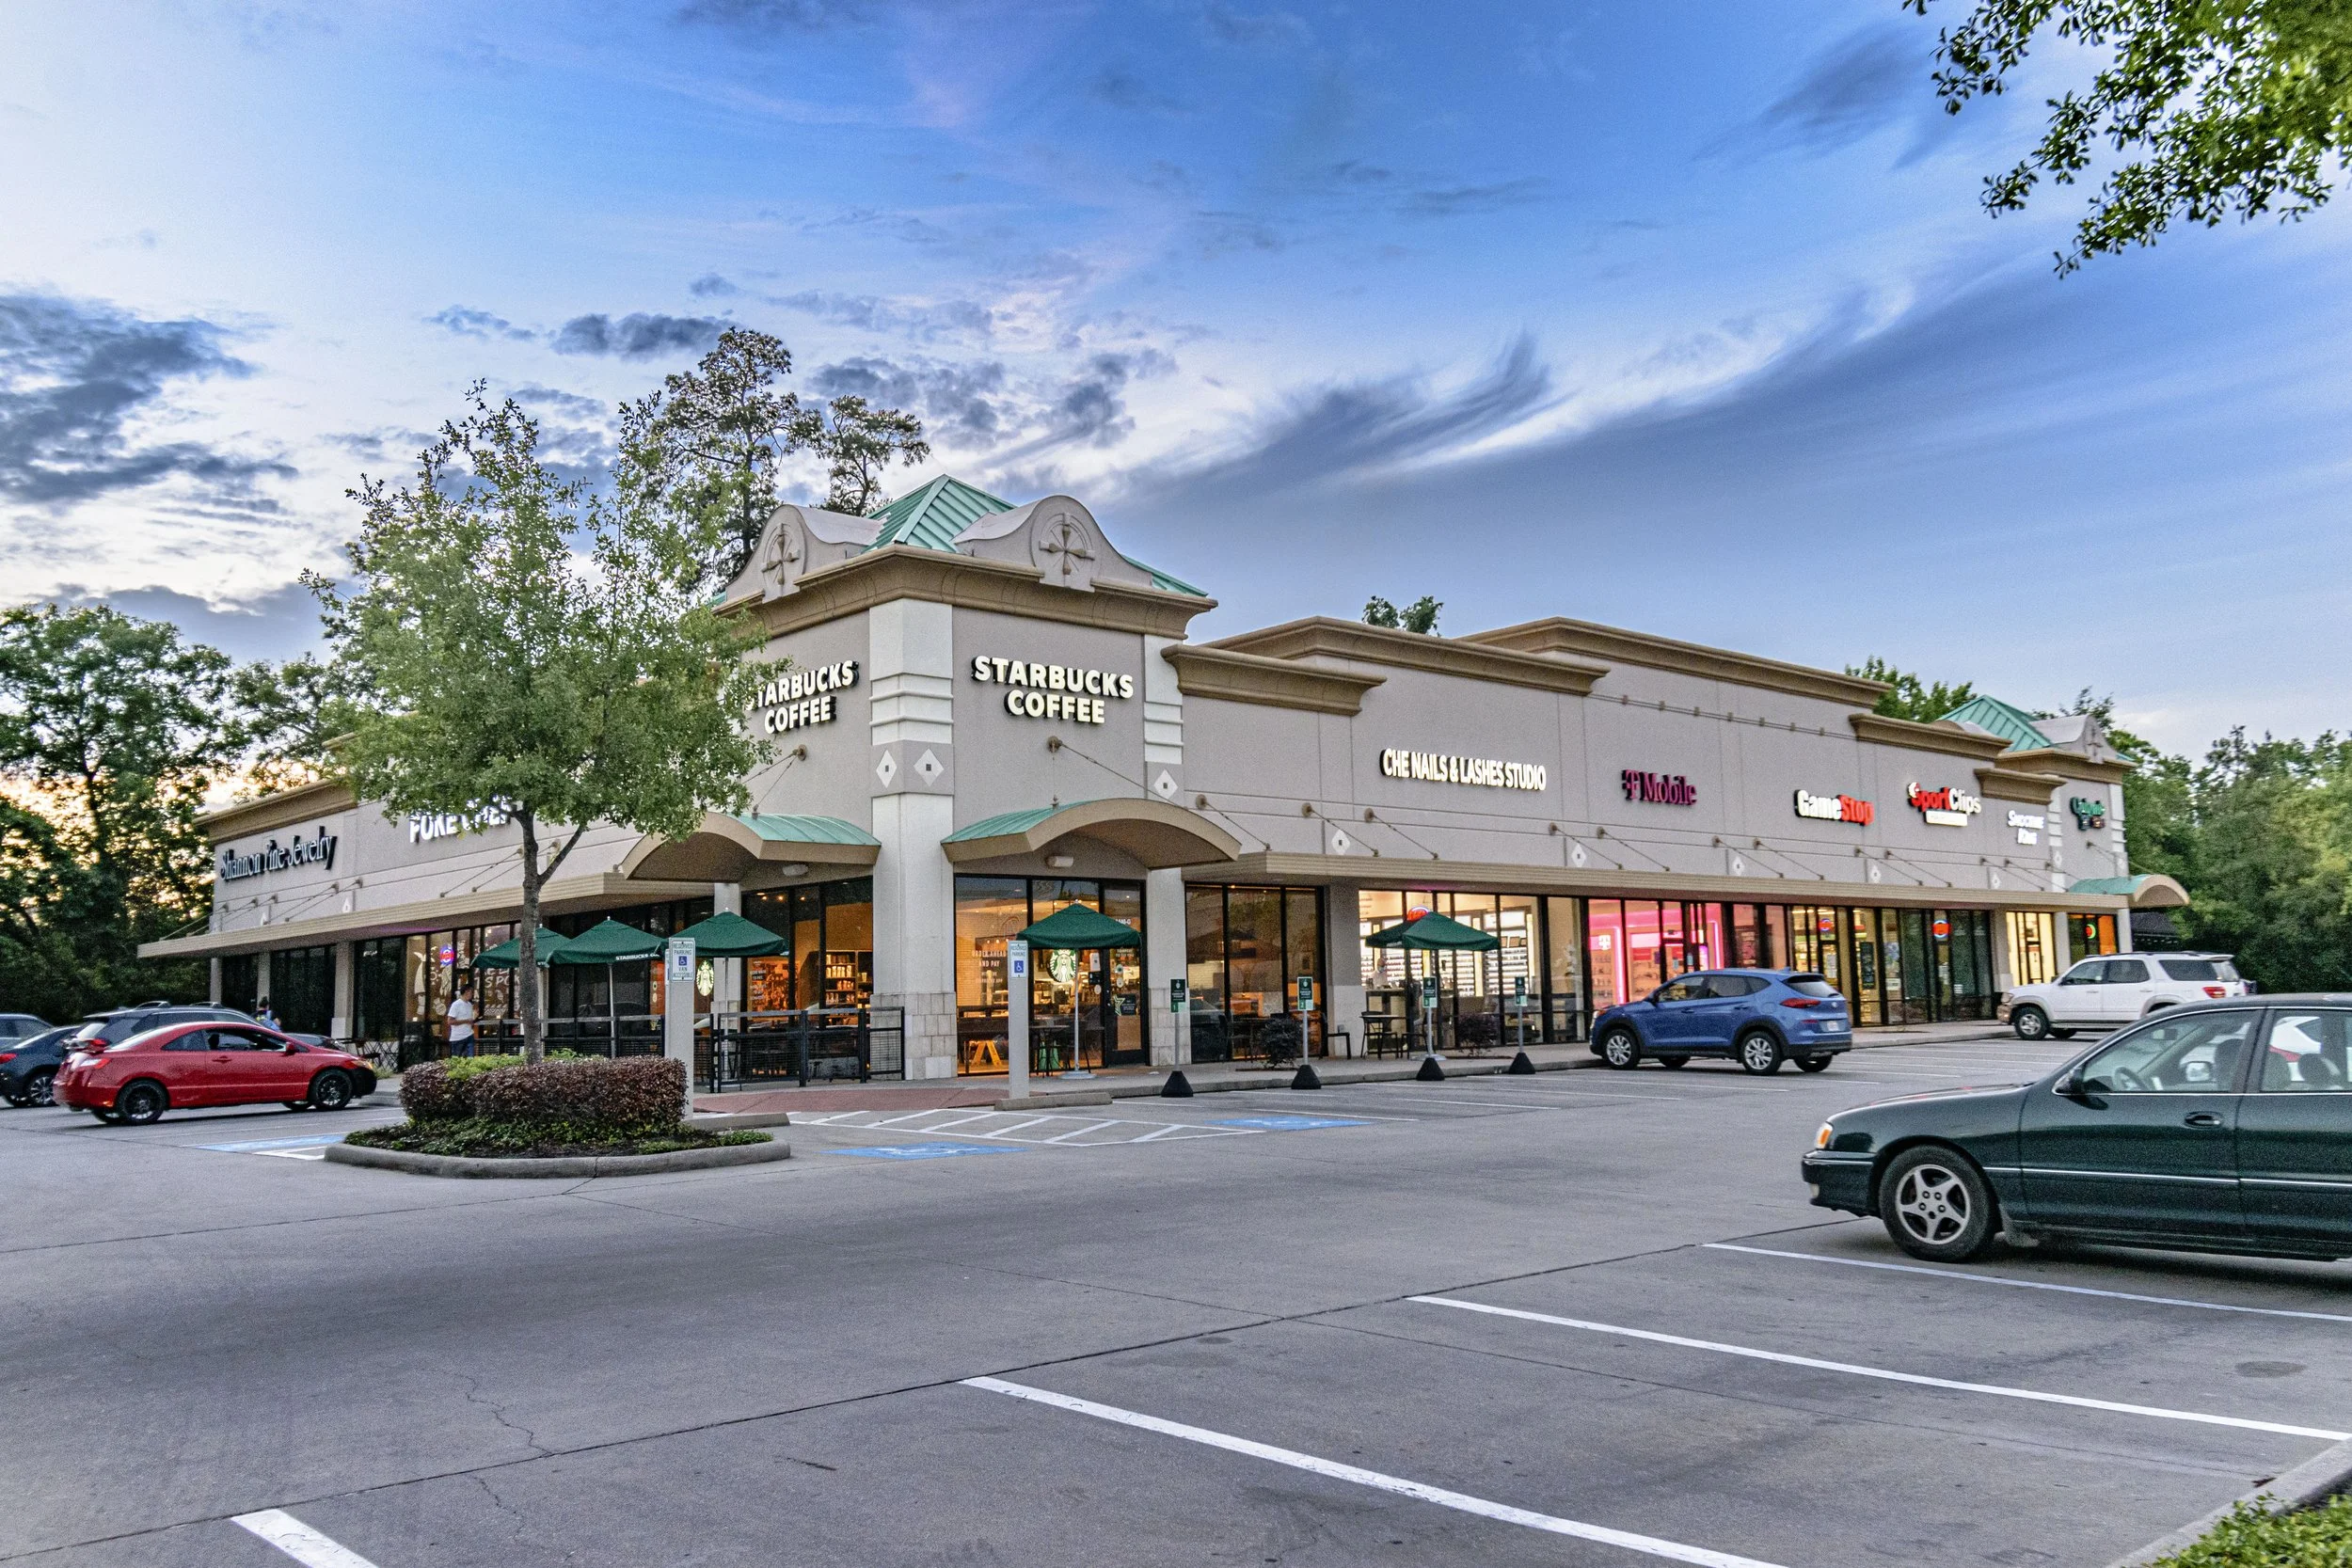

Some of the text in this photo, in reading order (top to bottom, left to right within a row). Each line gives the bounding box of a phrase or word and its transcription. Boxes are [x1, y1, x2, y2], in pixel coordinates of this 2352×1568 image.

[973, 656, 1134, 699] STARBUCKS
[764, 695, 834, 735] COFFEE
[1006, 689, 1105, 724] COFFEE
[1380, 748, 1548, 791] CHE NAILS & LASHES STUDIO
[1641, 771, 1697, 805] Mobile
[1795, 789, 1875, 826] GameStop
[220, 826, 338, 881] Shannon Fine Jewelry
